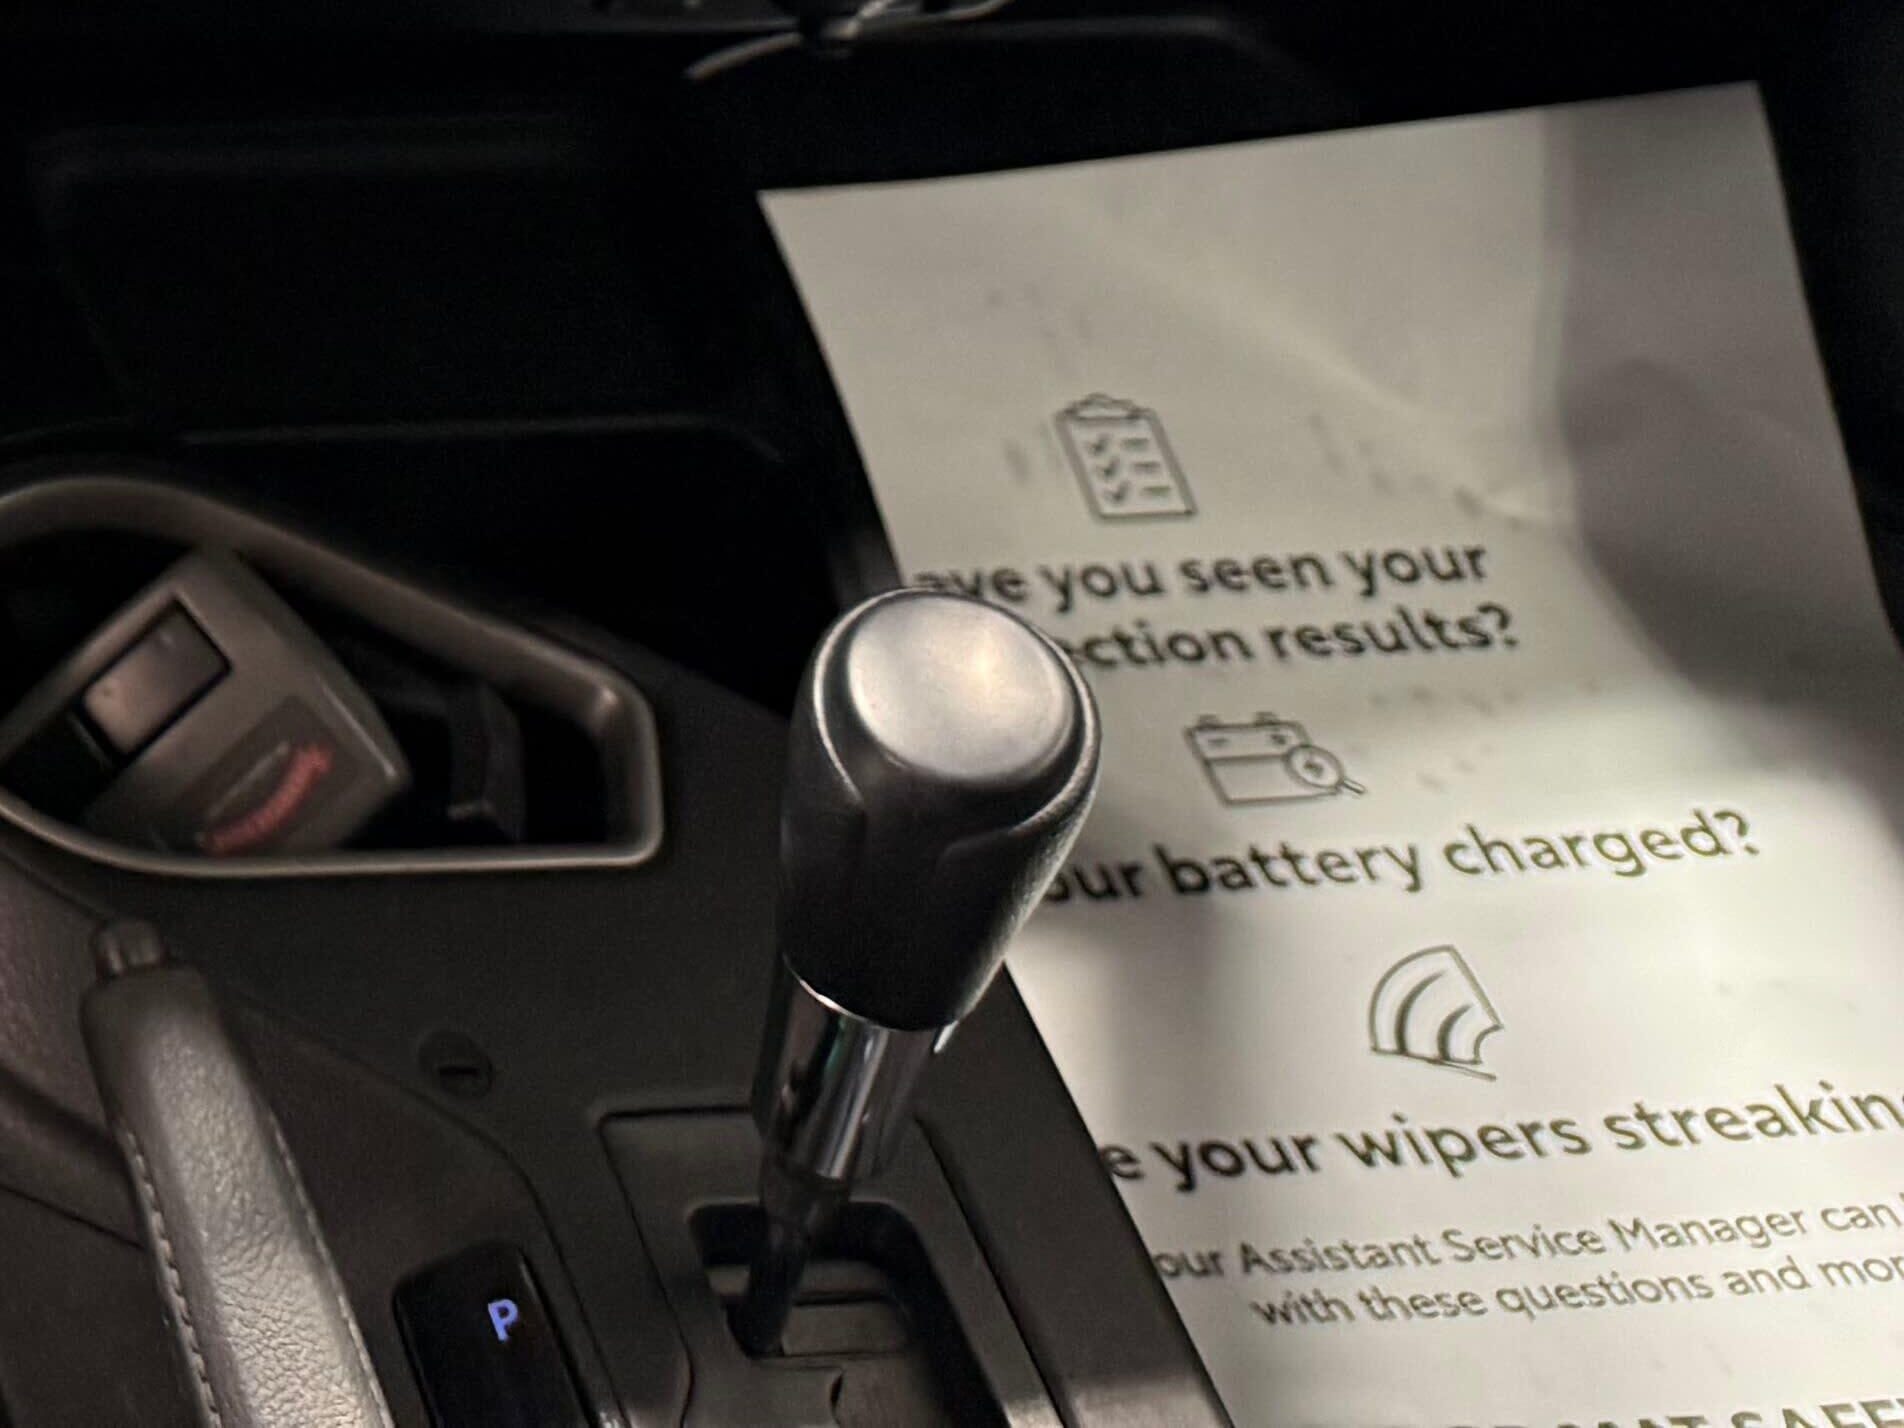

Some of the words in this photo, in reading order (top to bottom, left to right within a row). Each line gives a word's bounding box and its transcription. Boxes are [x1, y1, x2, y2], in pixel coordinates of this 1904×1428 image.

[1042, 560, 1166, 615] you
[1181, 550, 1333, 595] seen
[1342, 546, 1489, 598] your
[1268, 602, 1521, 660] results?
[1155, 841, 1420, 894] battery
[1445, 807, 1761, 878] charged?
[1155, 1129, 1321, 1193] your
[1337, 1111, 1591, 1180] wipers
[1603, 1082, 1904, 1153] streakin
[1240, 1236, 1443, 1275] Assistant
[1442, 1227, 1607, 1265] Service
[1608, 1210, 1809, 1250] Manager
[1820, 1203, 1903, 1233] can
[488, 1298, 519, 1341] P
[1250, 1287, 1356, 1325] with
[1357, 1283, 1489, 1321] these
[1495, 1270, 1715, 1321] questions
[1721, 1255, 1813, 1297] and
